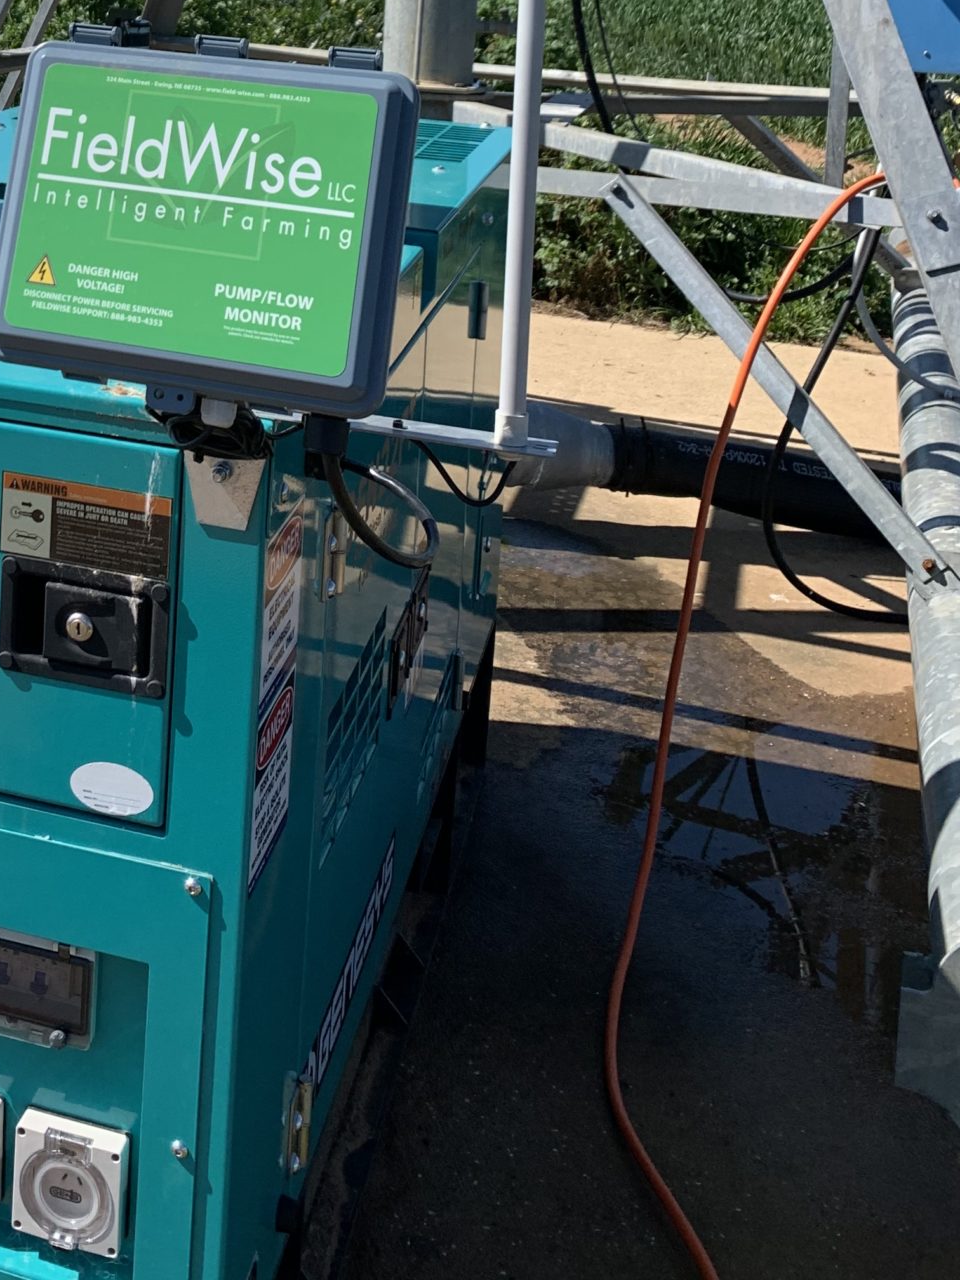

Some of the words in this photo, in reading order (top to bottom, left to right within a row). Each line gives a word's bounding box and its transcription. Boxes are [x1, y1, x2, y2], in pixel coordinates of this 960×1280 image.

[118, 77, 131, 85] Main
[40, 106, 322, 198] FieldWise
[327, 182, 356, 203] LLC
[33, 183, 201, 223] Intelligent
[222, 207, 353, 249] Farming
[68, 263, 110, 278] DANGER
[112, 270, 139, 282] HIGH
[76, 278, 125, 294] VOLTAGE!
[23, 288, 71, 303] DISCONNECT
[72, 295, 100, 307] POWER
[101, 300, 131, 312] BEFORE
[132, 304, 173, 318] SERVICING
[214, 283, 314, 311] PUMP/FLOW
[31, 300, 70, 314] FIELDWISE
[72, 306, 110, 319] SUPPORT:
[224, 306, 302, 331] MONITOR
[793, 462, 834, 480] TESTED
[21, 479, 68, 497] WARNING
[56, 500, 85, 511] IMPROPER
[85, 504, 116, 516] OPERATION
[116, 509, 129, 519] CAN
[130, 511, 147, 521] CAUS
[56, 508, 77, 517] SEVERE
[101, 514, 109, 522] OR
[110, 516, 128, 525] DEATH
[269, 516, 301, 584] DANGER
[259, 688, 291, 766] DANGER
